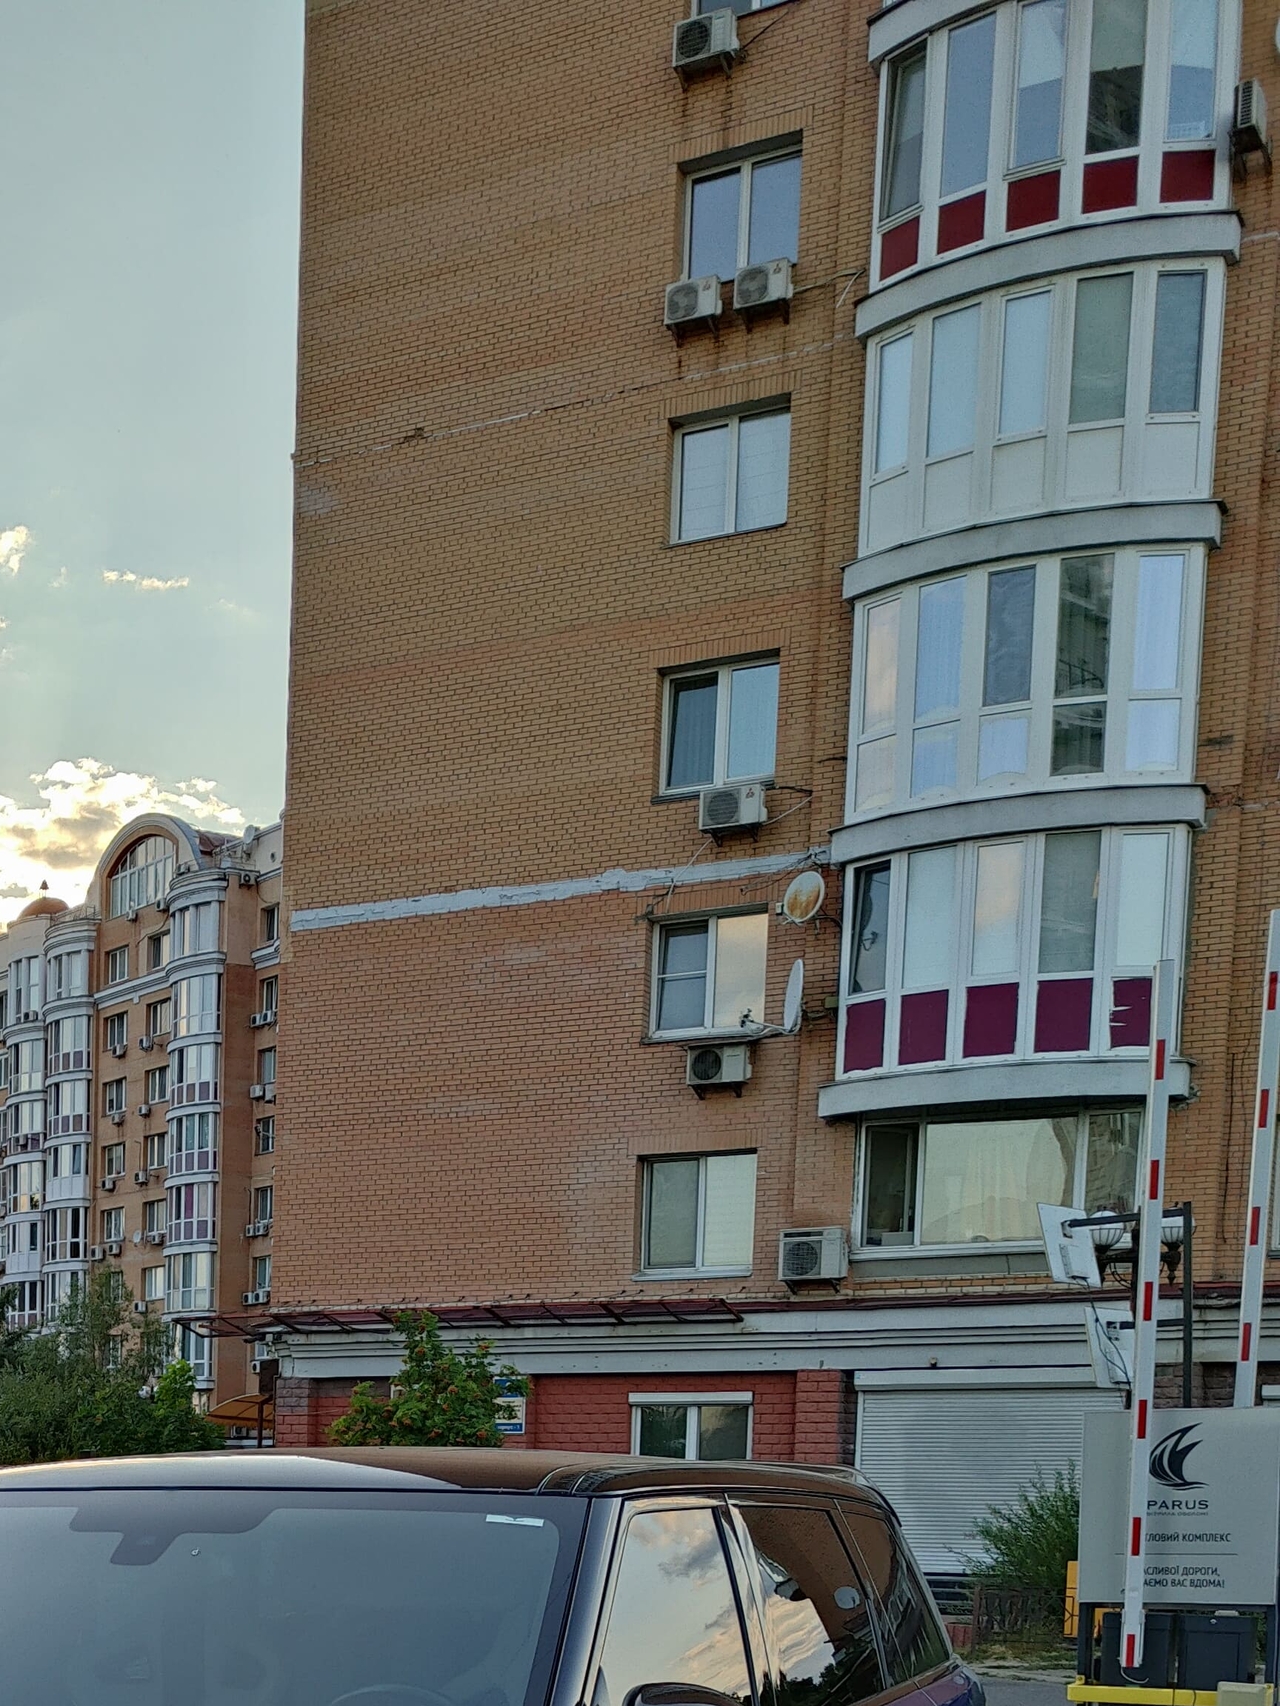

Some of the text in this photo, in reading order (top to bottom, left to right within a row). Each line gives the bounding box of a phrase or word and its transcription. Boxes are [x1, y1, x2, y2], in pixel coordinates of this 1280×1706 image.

[1147, 1499, 1209, 1510] PARUS
[1182, 1533, 1231, 1542] КОМПЛЕКС
[1181, 1566, 1221, 1577] ДОРОГИ,
[1143, 1578, 1225, 1588] АЄМО ВАС ВДОМА!
